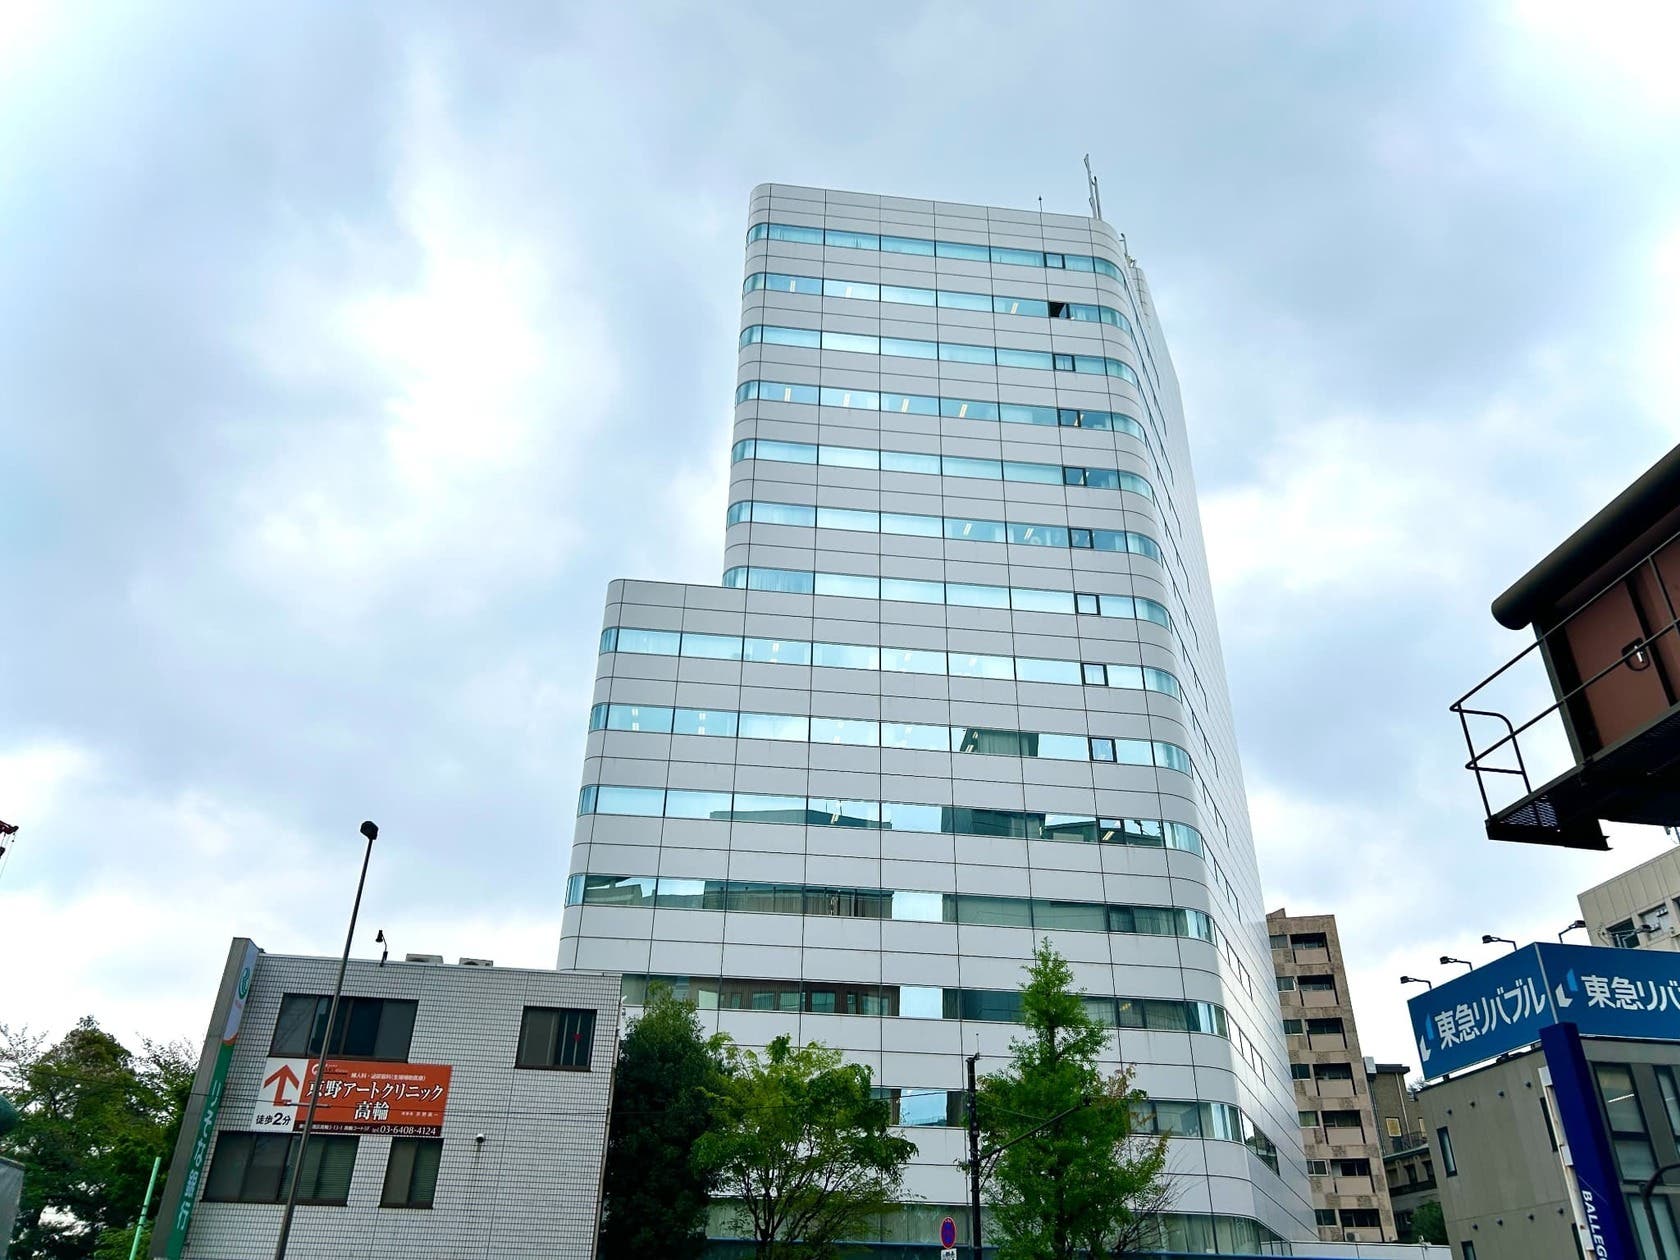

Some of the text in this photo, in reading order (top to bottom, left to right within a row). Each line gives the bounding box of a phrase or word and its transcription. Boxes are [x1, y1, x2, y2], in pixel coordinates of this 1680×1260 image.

[1434, 977, 1546, 1050] 東急リバブル
[256, 1112, 291, 1126] 徒歩2分
[354, 1100, 390, 1121] 高輪
[380, 1124, 437, 1136] 03-6408-4124
[1582, 1190, 1608, 1260] BALLEG
